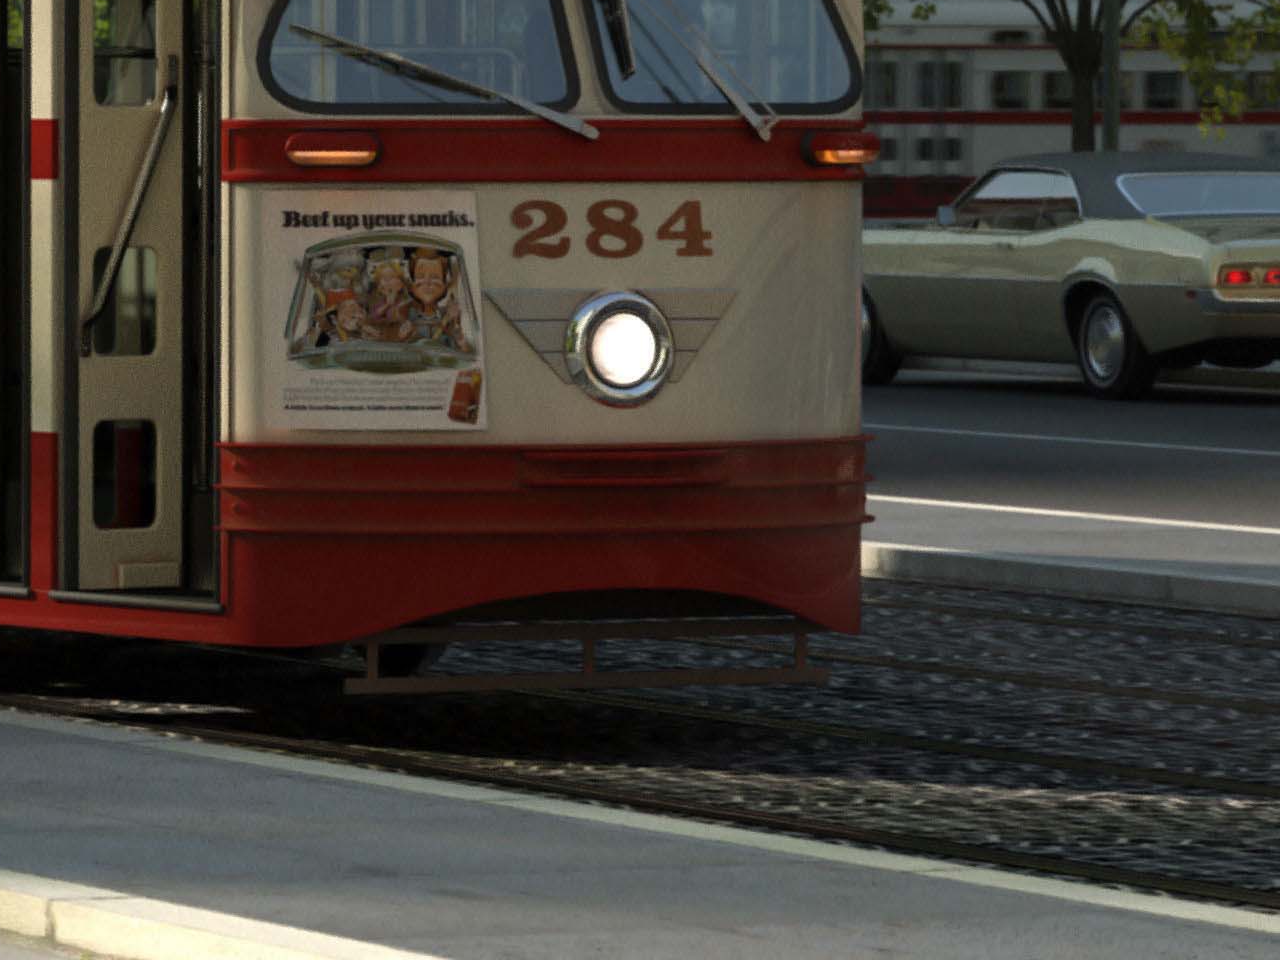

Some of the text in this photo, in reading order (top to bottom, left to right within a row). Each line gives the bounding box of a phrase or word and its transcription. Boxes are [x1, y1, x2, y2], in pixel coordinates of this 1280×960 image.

[282, 210, 475, 230] Beef up your snacks.
[510, 199, 714, 259] 284
